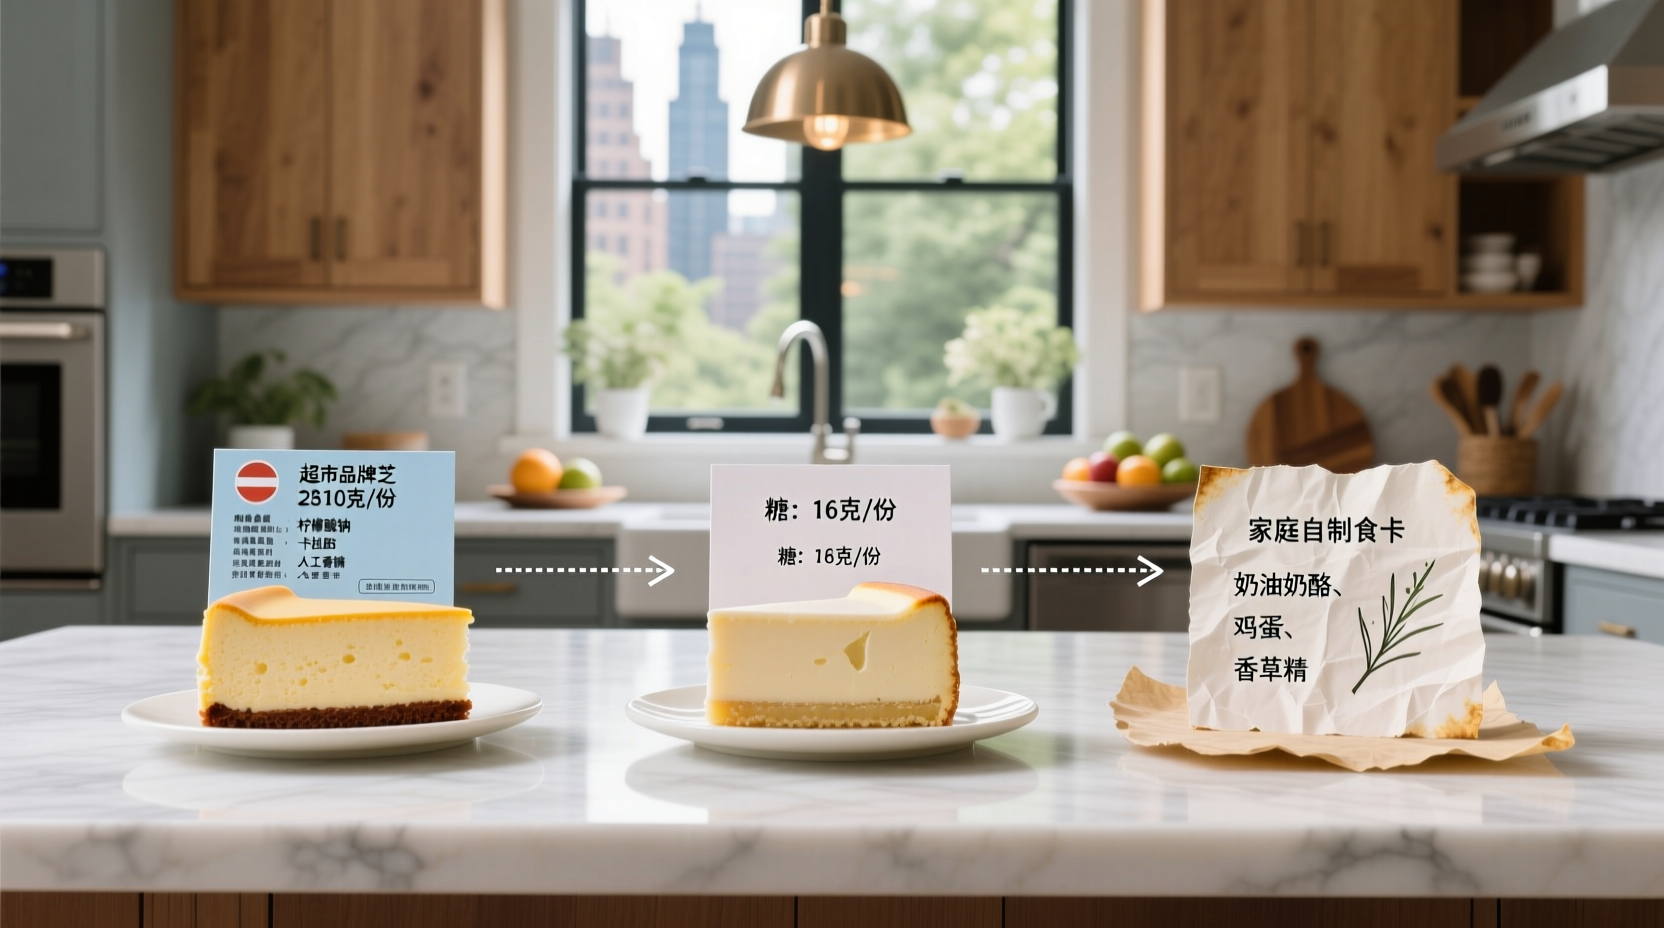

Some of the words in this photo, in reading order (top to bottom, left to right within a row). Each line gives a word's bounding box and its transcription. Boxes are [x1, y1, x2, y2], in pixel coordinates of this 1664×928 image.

[299, 462, 397, 485] 超市品牌芝
[1248, 516, 1406, 544] 家庭自制食卡
[1233, 571, 1343, 598] 奶油奶酪、
[1233, 615, 1293, 640] 鸡蛋、
[1234, 655, 1309, 683] 香草精
